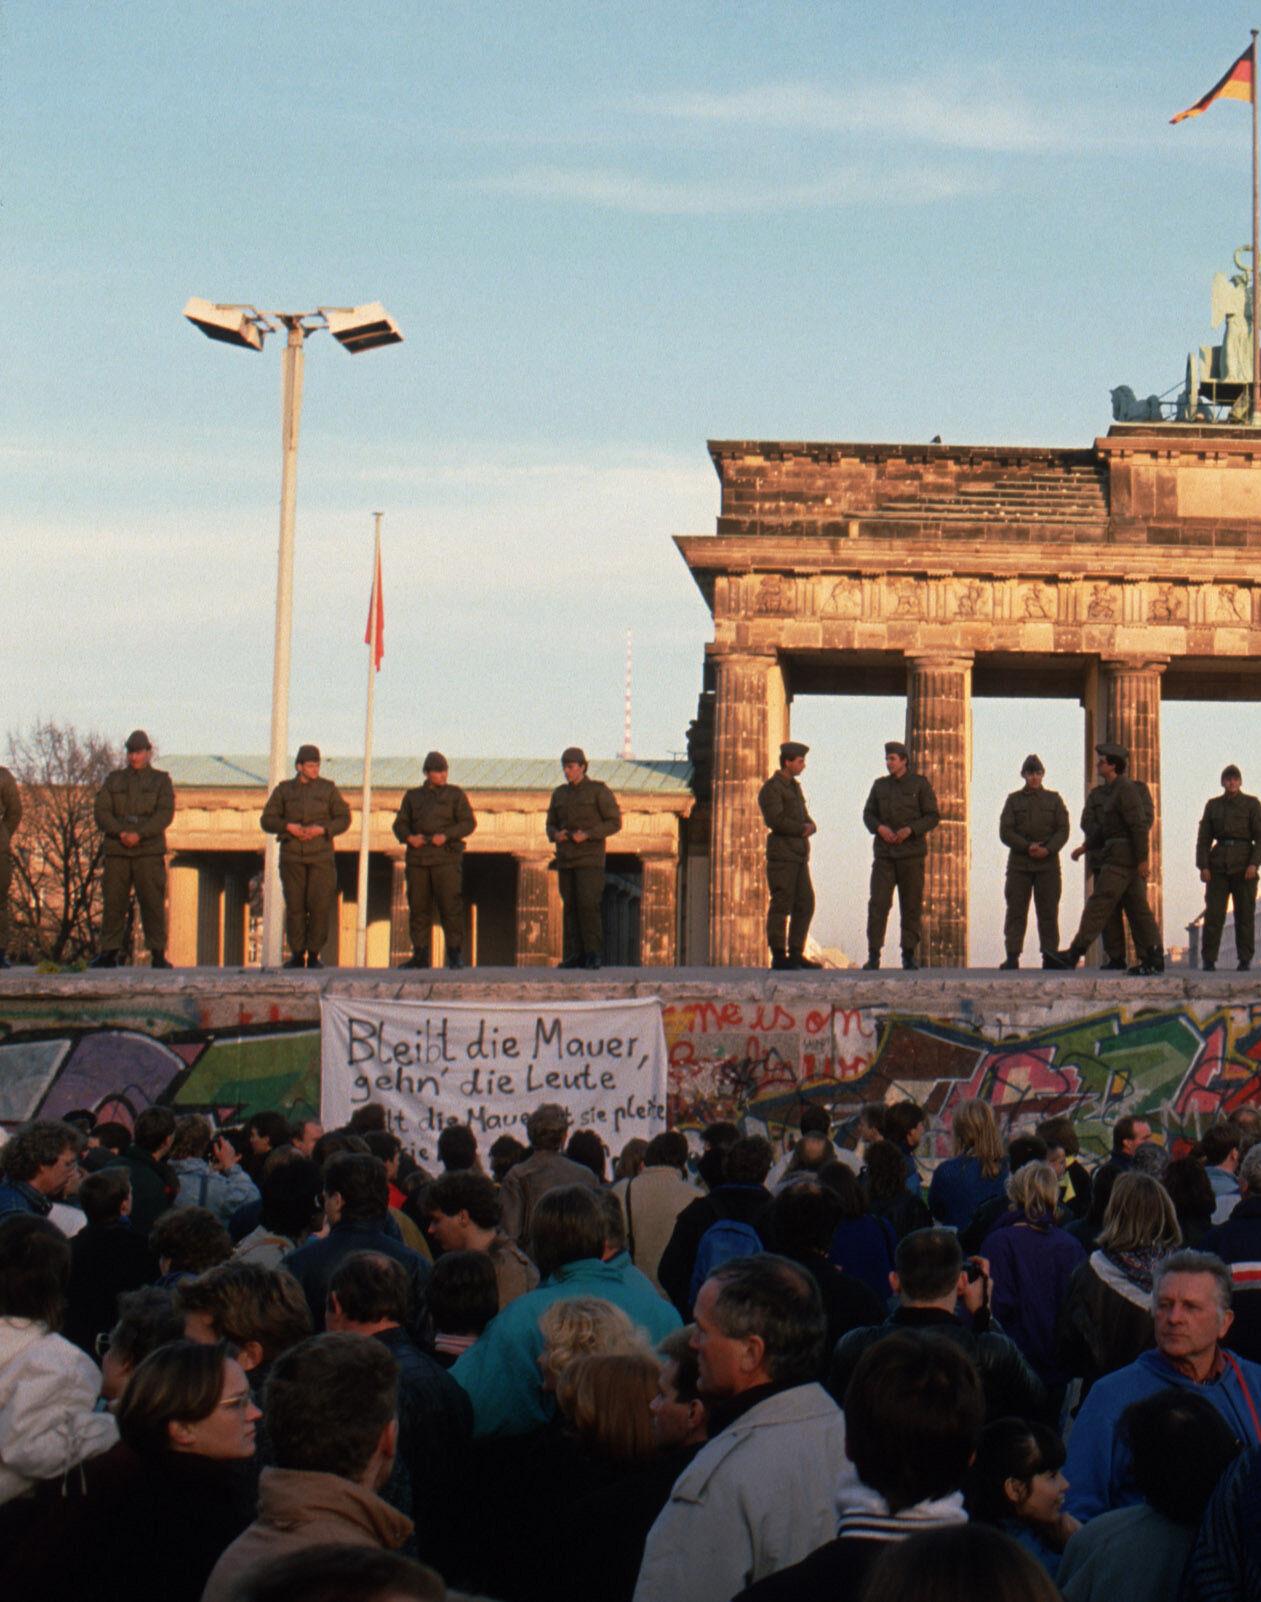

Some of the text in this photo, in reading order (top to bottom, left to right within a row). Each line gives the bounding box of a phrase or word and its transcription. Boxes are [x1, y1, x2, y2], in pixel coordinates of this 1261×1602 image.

[347, 1017, 650, 1070] Bleibt die Mauer,
[460, 1068, 515, 1095] die
[527, 1064, 617, 1093] Leute
[466, 1105, 532, 1133] Maue
[580, 1106, 608, 1126] sie
